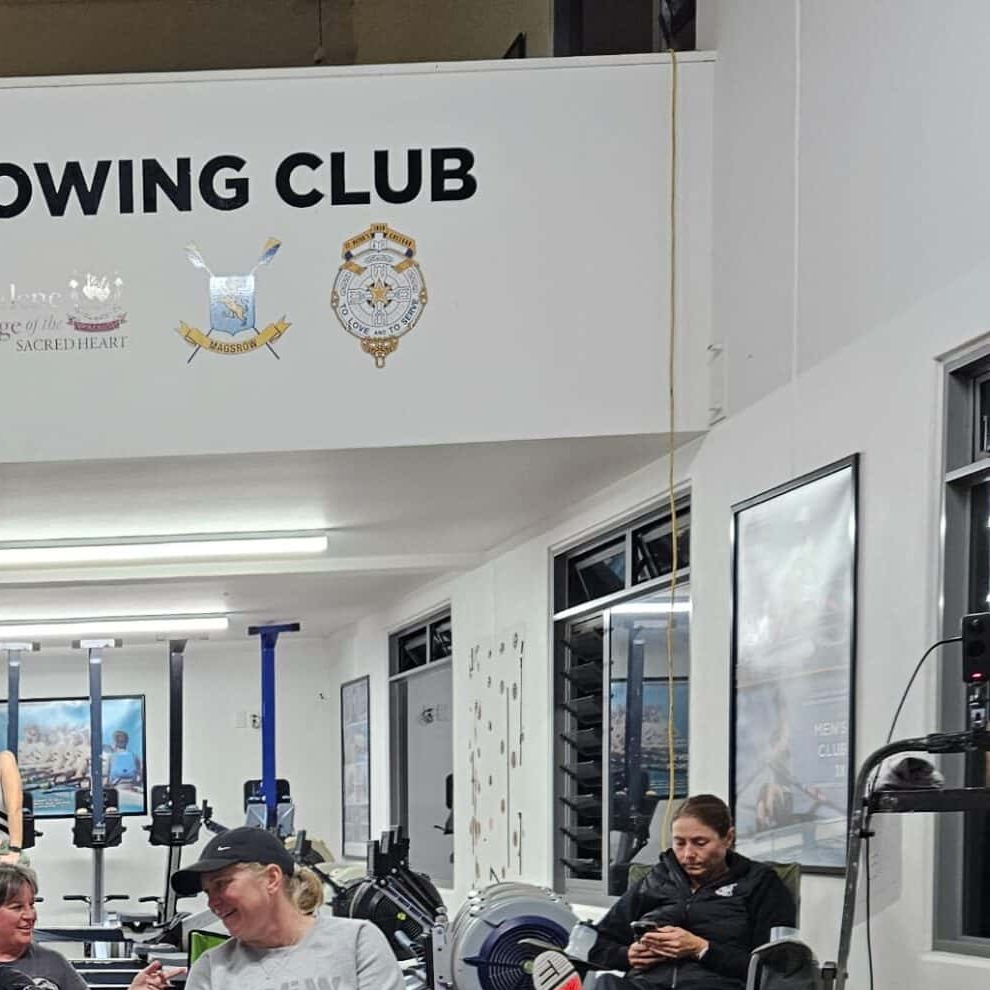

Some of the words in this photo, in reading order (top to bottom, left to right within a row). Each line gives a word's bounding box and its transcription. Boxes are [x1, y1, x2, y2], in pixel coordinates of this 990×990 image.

[275, 147, 478, 208] CLUB
[25, 318, 42, 335] of
[348, 316, 370, 335] LOVE
[389, 323, 401, 334] TO
[16, 338, 75, 352] SACRED
[78, 335, 129, 350] HEART
